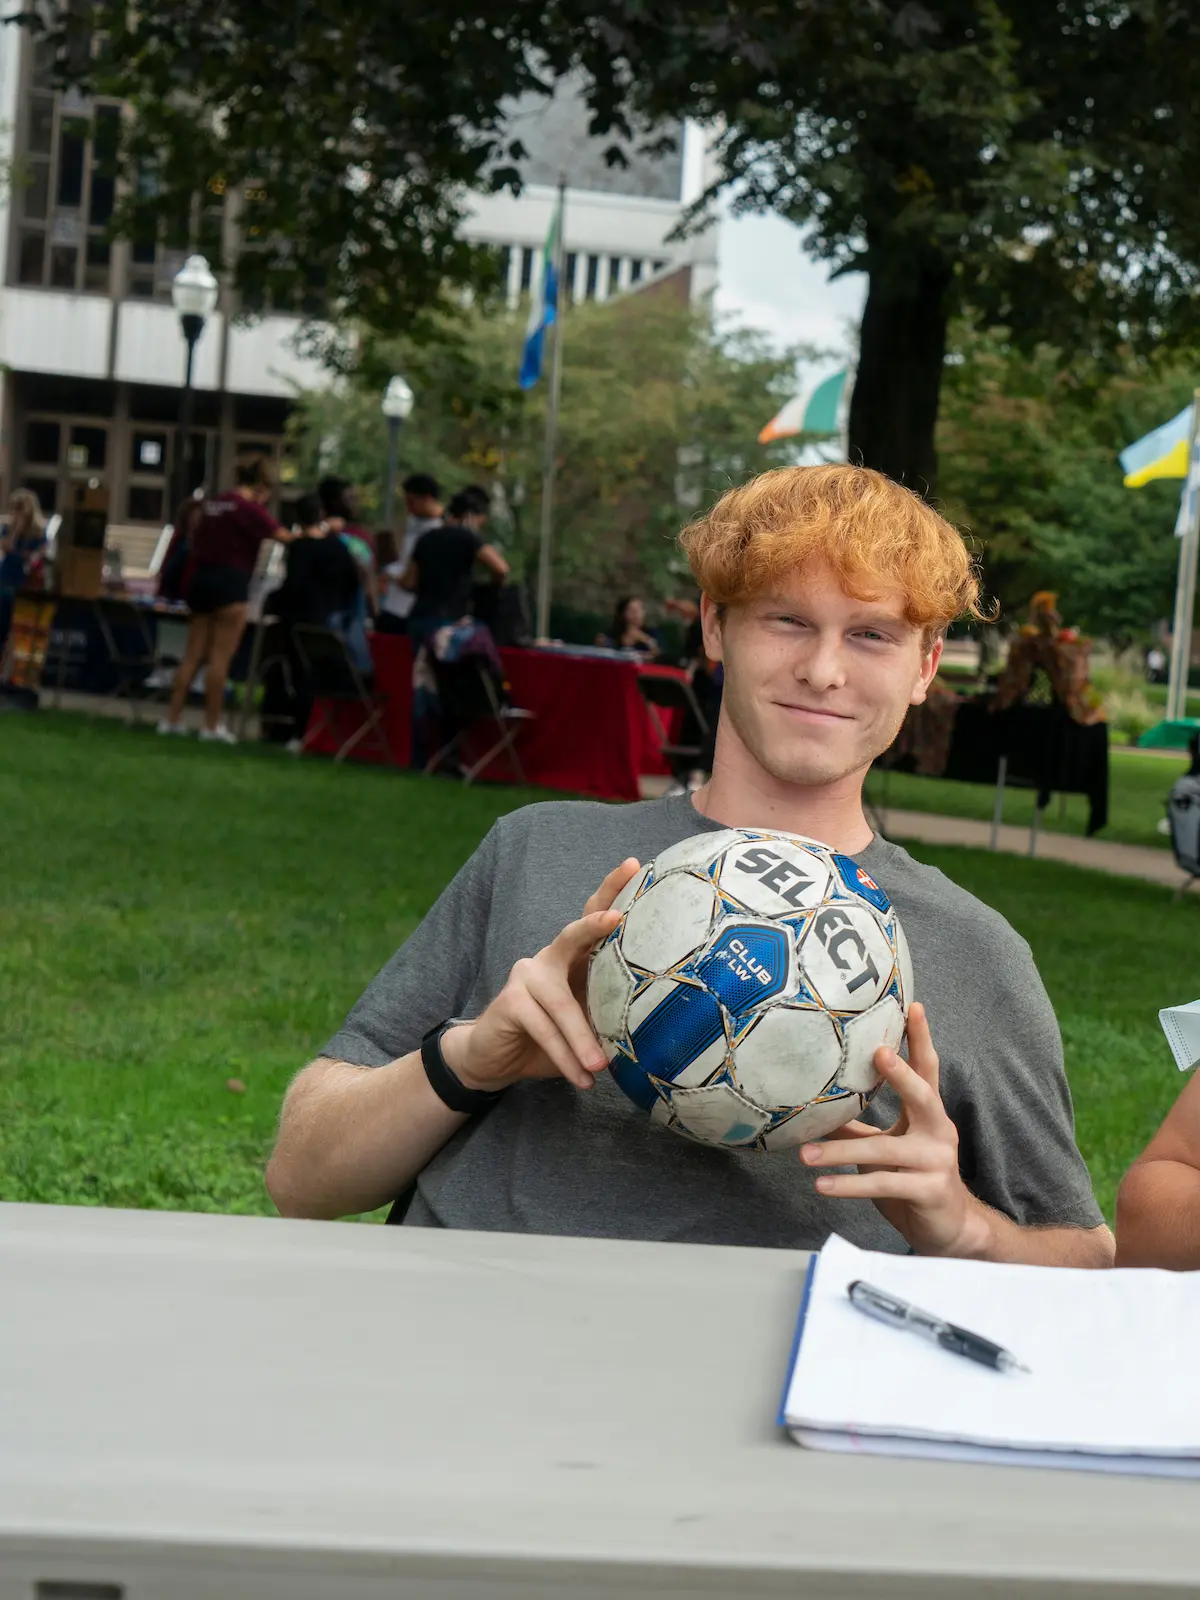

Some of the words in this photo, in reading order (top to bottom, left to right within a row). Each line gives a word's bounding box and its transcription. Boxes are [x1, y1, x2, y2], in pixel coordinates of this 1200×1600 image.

[728, 939, 772, 985] CLUB
[735, 848, 816, 908] SEL
[814, 908, 880, 994] ECT
